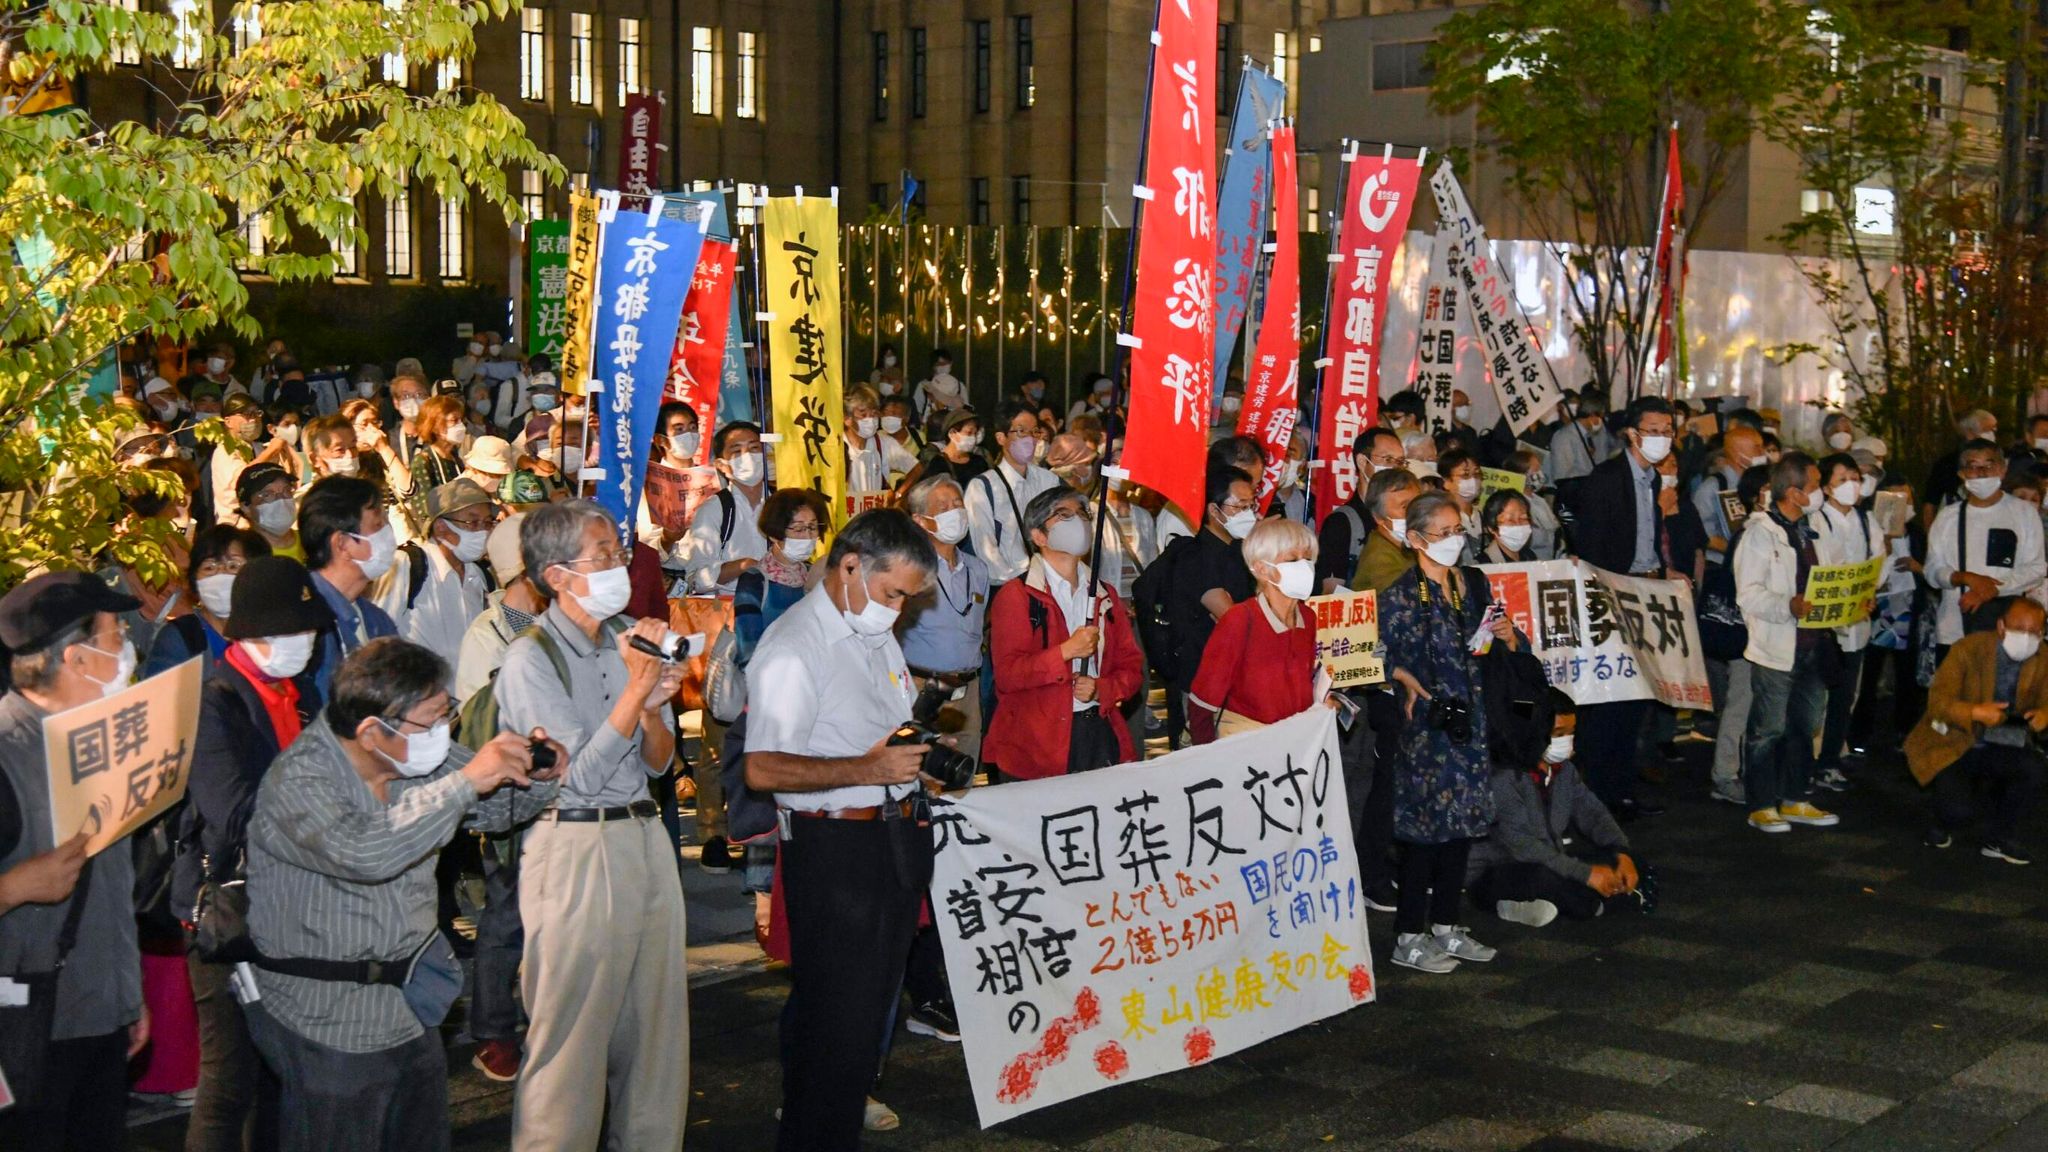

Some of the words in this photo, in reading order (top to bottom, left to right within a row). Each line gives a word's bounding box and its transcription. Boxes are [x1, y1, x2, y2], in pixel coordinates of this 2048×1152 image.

[67, 700, 149, 785] 国葬
[121, 738, 187, 822] 反対
[1085, 870, 1221, 928] とんでもない
[1240, 834, 1340, 905] 国民の声
[1119, 931, 1351, 1041] 東山健康友の会
